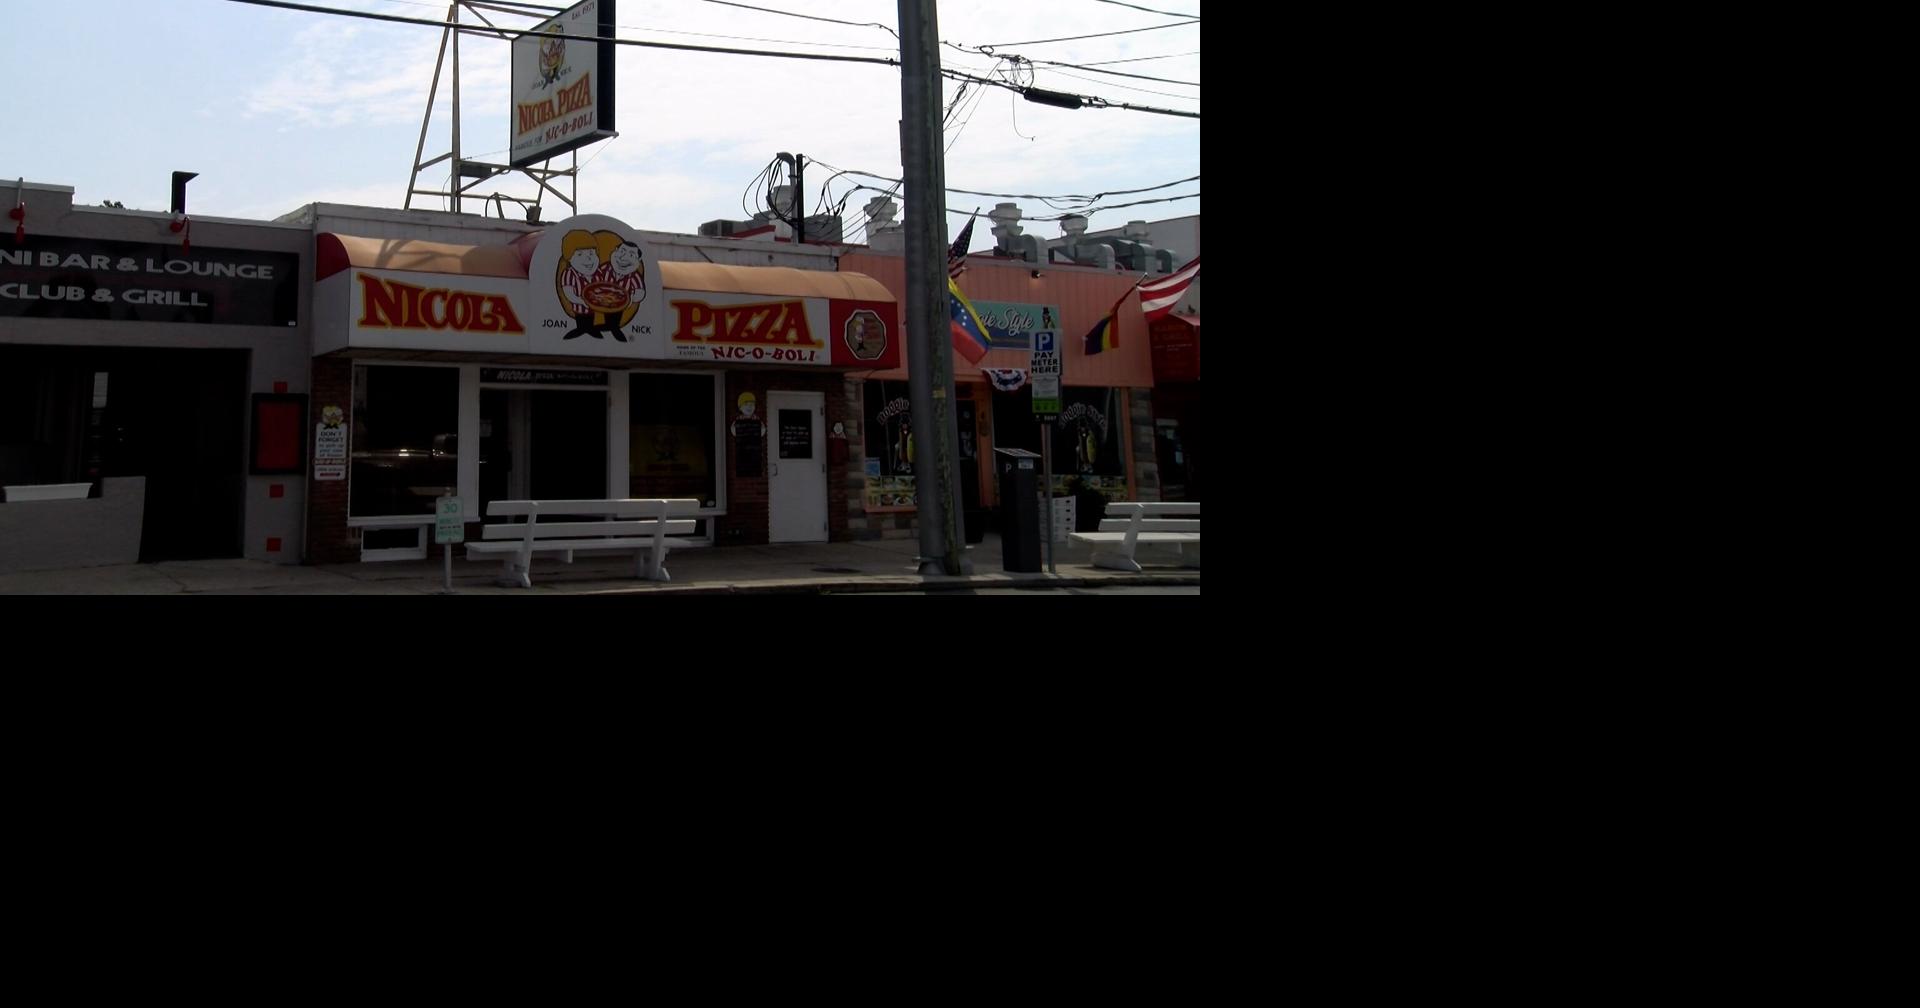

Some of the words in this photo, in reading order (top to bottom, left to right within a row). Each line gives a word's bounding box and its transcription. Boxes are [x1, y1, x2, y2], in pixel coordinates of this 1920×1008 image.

[517, 99, 555, 135] NICOLA
[556, 72, 592, 116] PIZZA
[545, 112, 593, 144] NIC-O-BOLI
[40, 251, 110, 271] BAR
[116, 256, 139, 273] &
[146, 257, 274, 280] LOUNGE
[0, 283, 86, 302] CLUB
[91, 286, 115, 303] &
[122, 288, 208, 307] GRILL
[357, 272, 526, 334] NICOLA
[542, 319, 568, 328] JOAN
[631, 325, 652, 334] NICK
[671, 298, 825, 348] PIZZA
[998, 306, 1034, 337] Style
[711, 346, 816, 362] NIC-O-BOLI
[1031, 366, 1059, 374] HERE
[443, 503, 457, 514] 30
